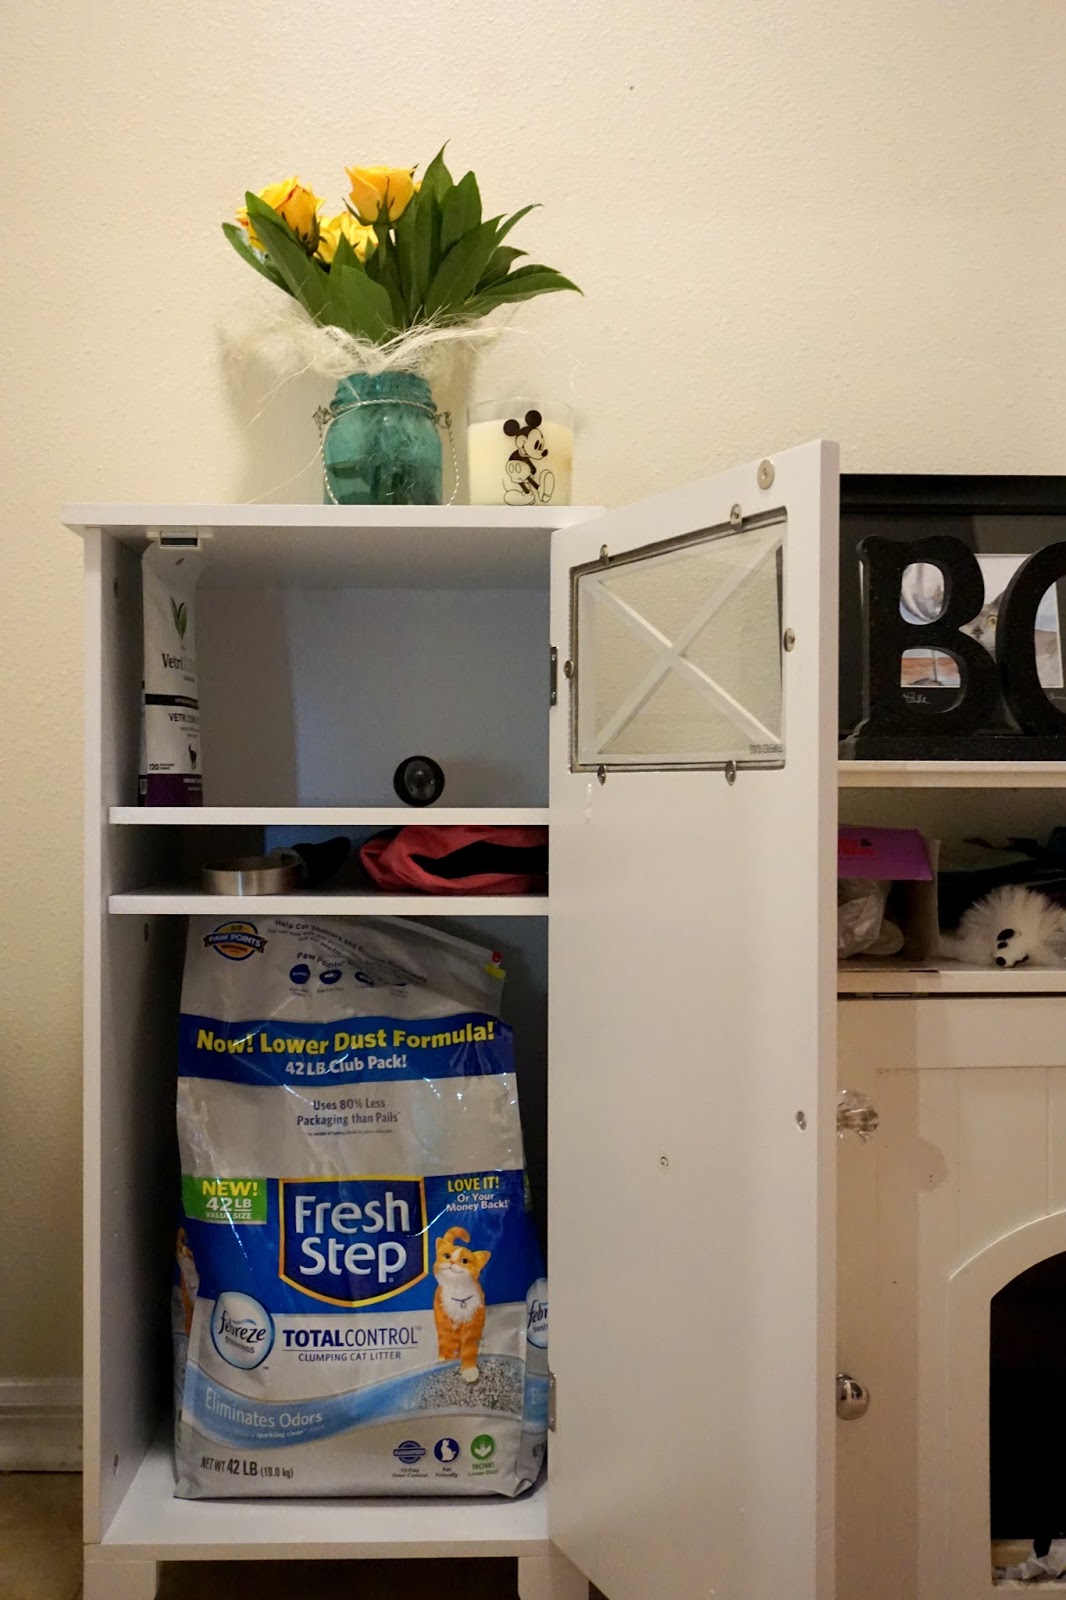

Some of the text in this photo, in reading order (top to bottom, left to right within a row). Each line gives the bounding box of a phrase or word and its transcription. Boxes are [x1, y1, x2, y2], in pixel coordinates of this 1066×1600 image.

[208, 934, 261, 948] PAW POINTS
[296, 952, 316, 960] Paw
[196, 1021, 495, 1055] Now! Lower Dust Formula!
[285, 1054, 407, 1076] 42 LB Club Pack!
[313, 1097, 386, 1111] Uses 80% Less
[297, 1113, 349, 1128] Packaging
[352, 1112, 374, 1124] than
[202, 1180, 258, 1197] NEW!
[447, 1176, 500, 1193] LOVE IT!
[206, 1196, 253, 1212] 42 LB
[446, 1199, 509, 1212] Money Back!
[457, 1193, 495, 1203] Or Your
[206, 1211, 252, 1220] VALU SIZE
[295, 1191, 410, 1235] Fresh
[299, 1236, 407, 1284] Step
[218, 1310, 268, 1344] febreze
[298, 1351, 401, 1363] CLUMPING CAT LITTER
[204, 1386, 324, 1429] Eliminates Odors
[199, 1455, 215, 1471] NET
[214, 1458, 226, 1472] WT
[227, 1458, 240, 1475] 42
[242, 1460, 259, 1477] LB
[281, 1467, 294, 1480] kg)
